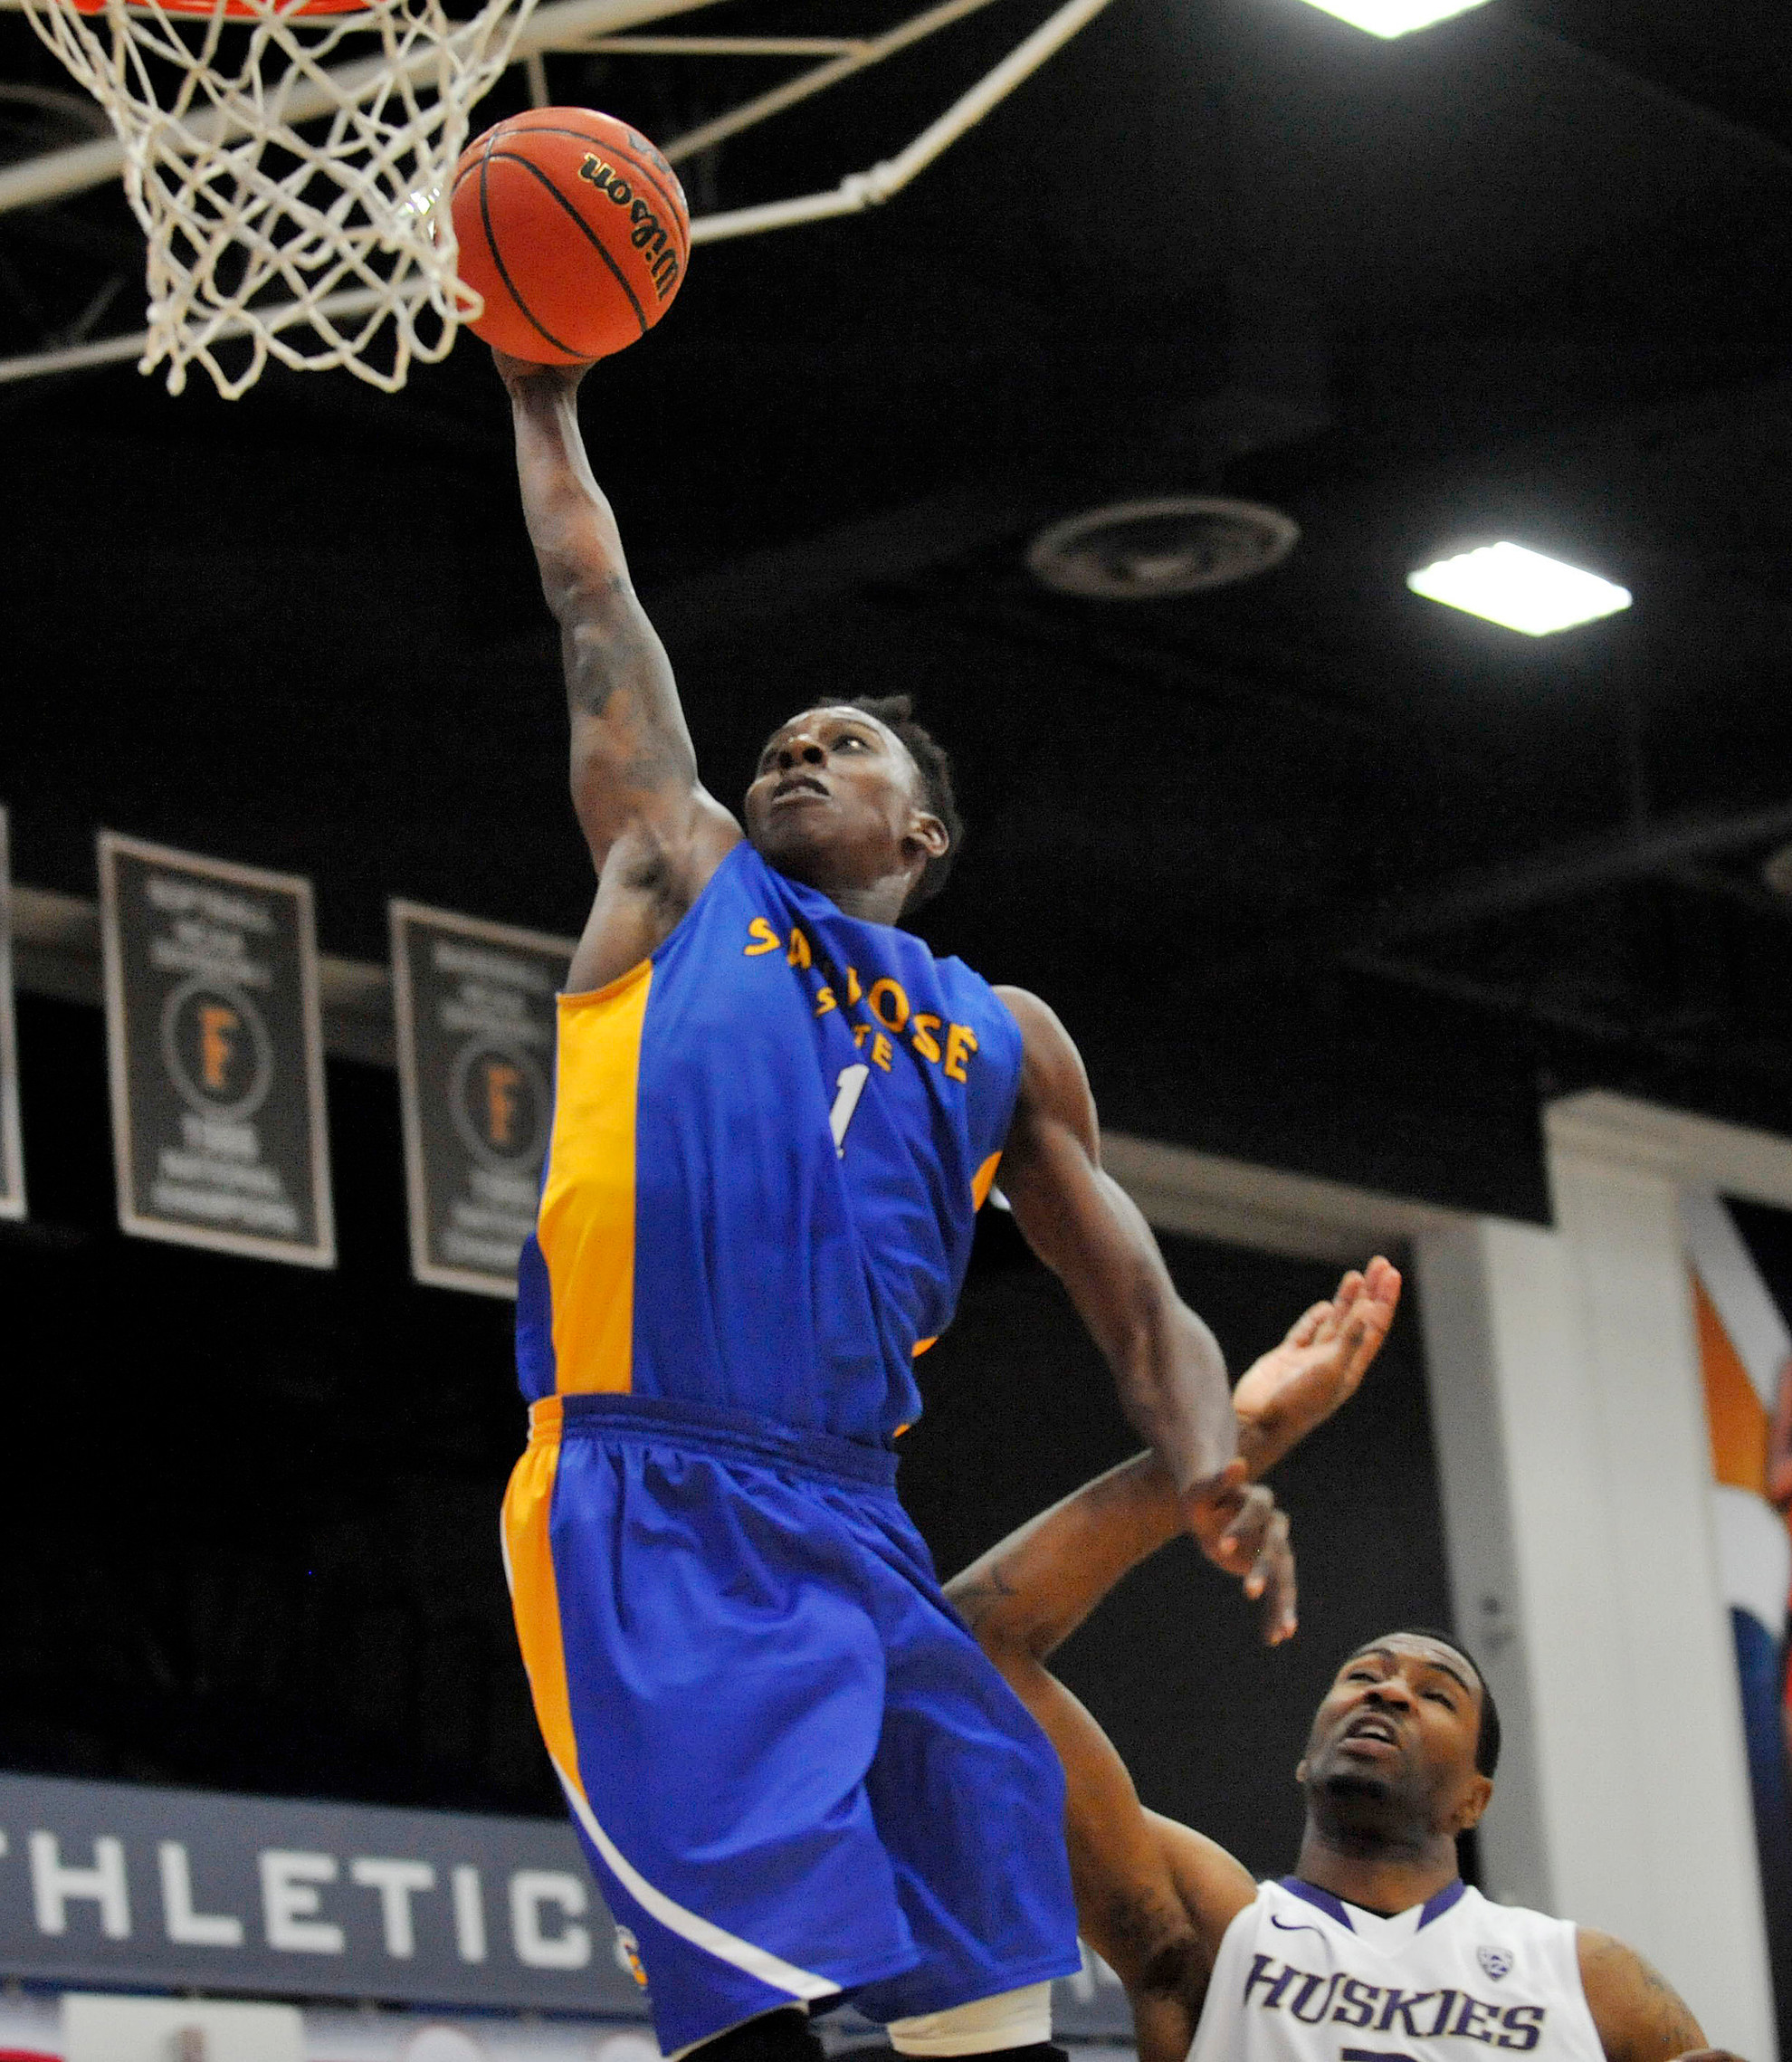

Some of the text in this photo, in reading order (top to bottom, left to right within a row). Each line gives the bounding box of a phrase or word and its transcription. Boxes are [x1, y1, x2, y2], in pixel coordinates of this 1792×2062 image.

[577, 151, 679, 301] Wilson
[743, 916, 813, 970] SA
[1244, 1952, 1545, 2051] HUSKIES
